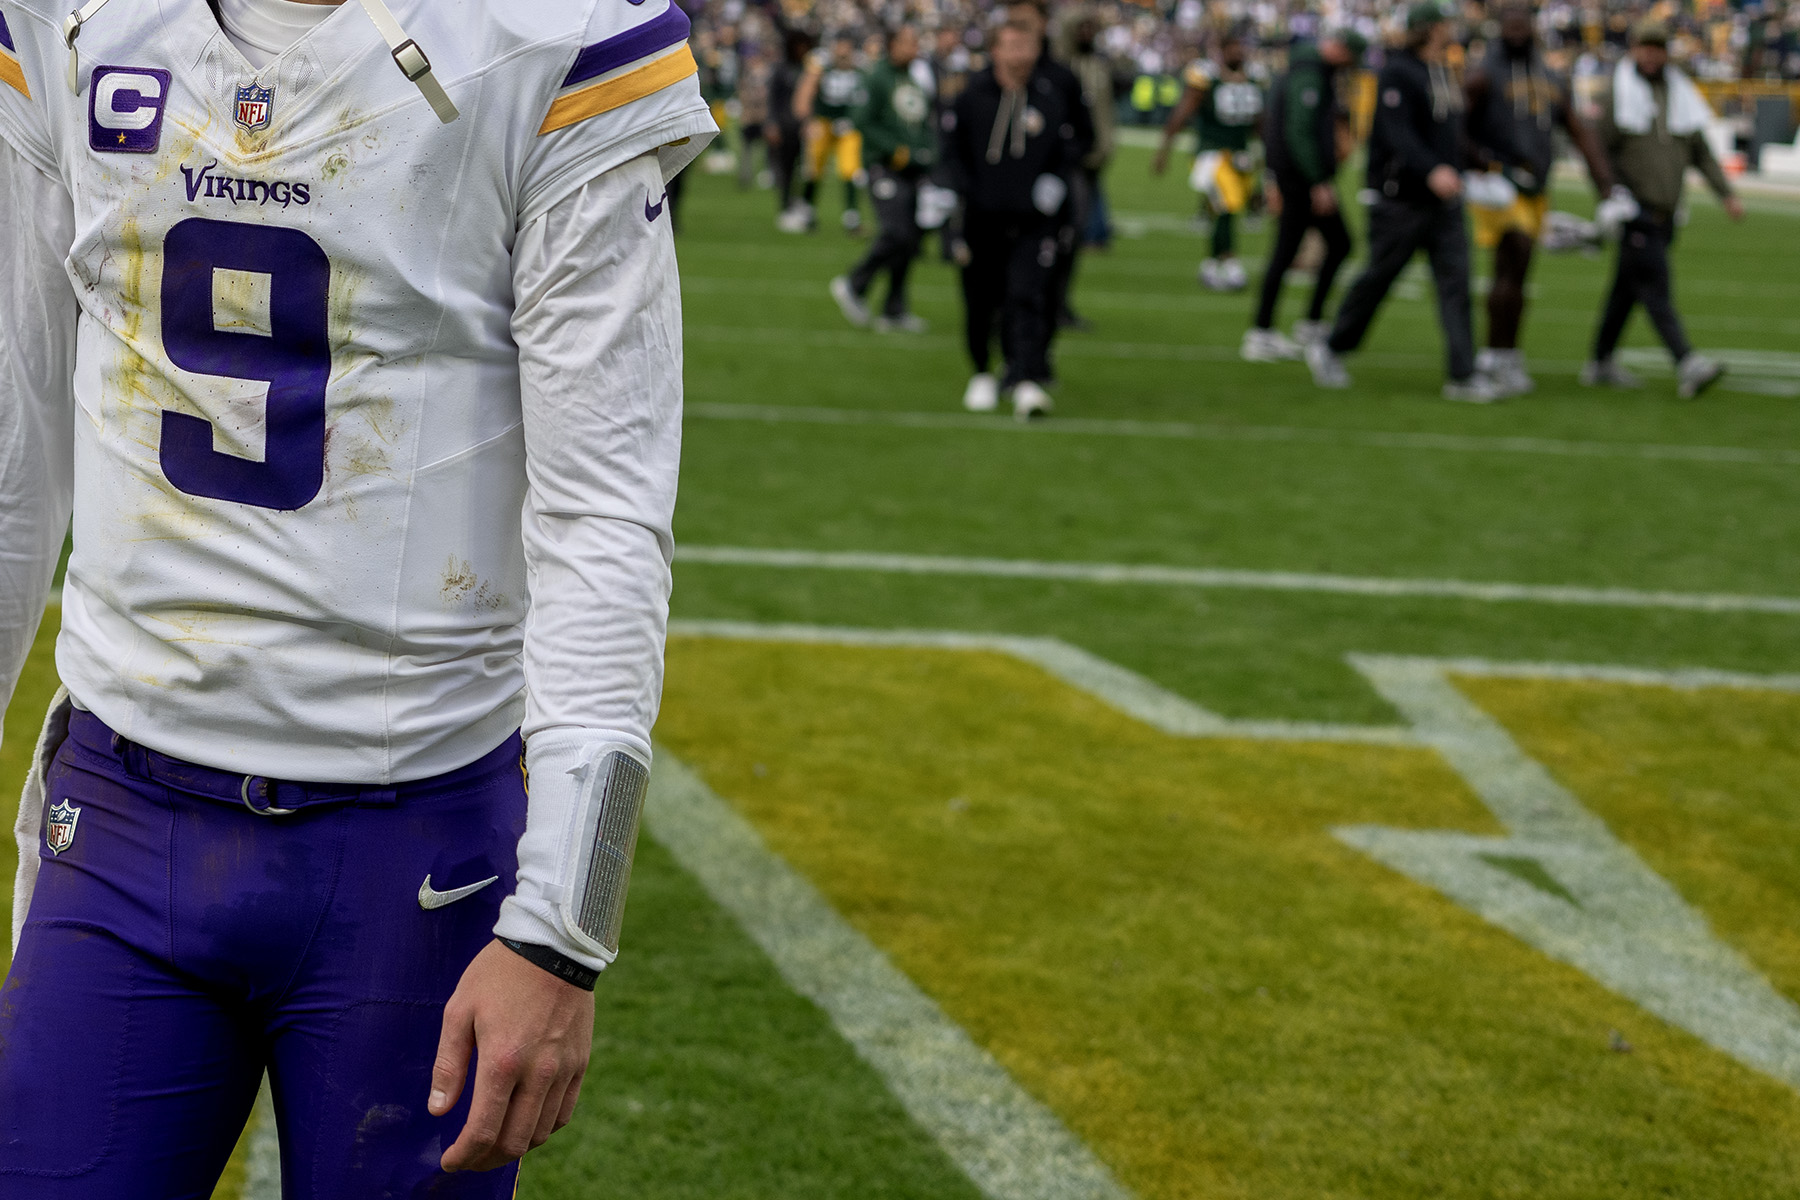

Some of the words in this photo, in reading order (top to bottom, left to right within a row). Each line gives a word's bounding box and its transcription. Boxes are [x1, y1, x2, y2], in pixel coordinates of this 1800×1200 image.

[93, 72, 162, 130] C
[238, 102, 265, 125] NFL
[158, 216, 332, 512] 9
[50, 824, 67, 846] NFL
